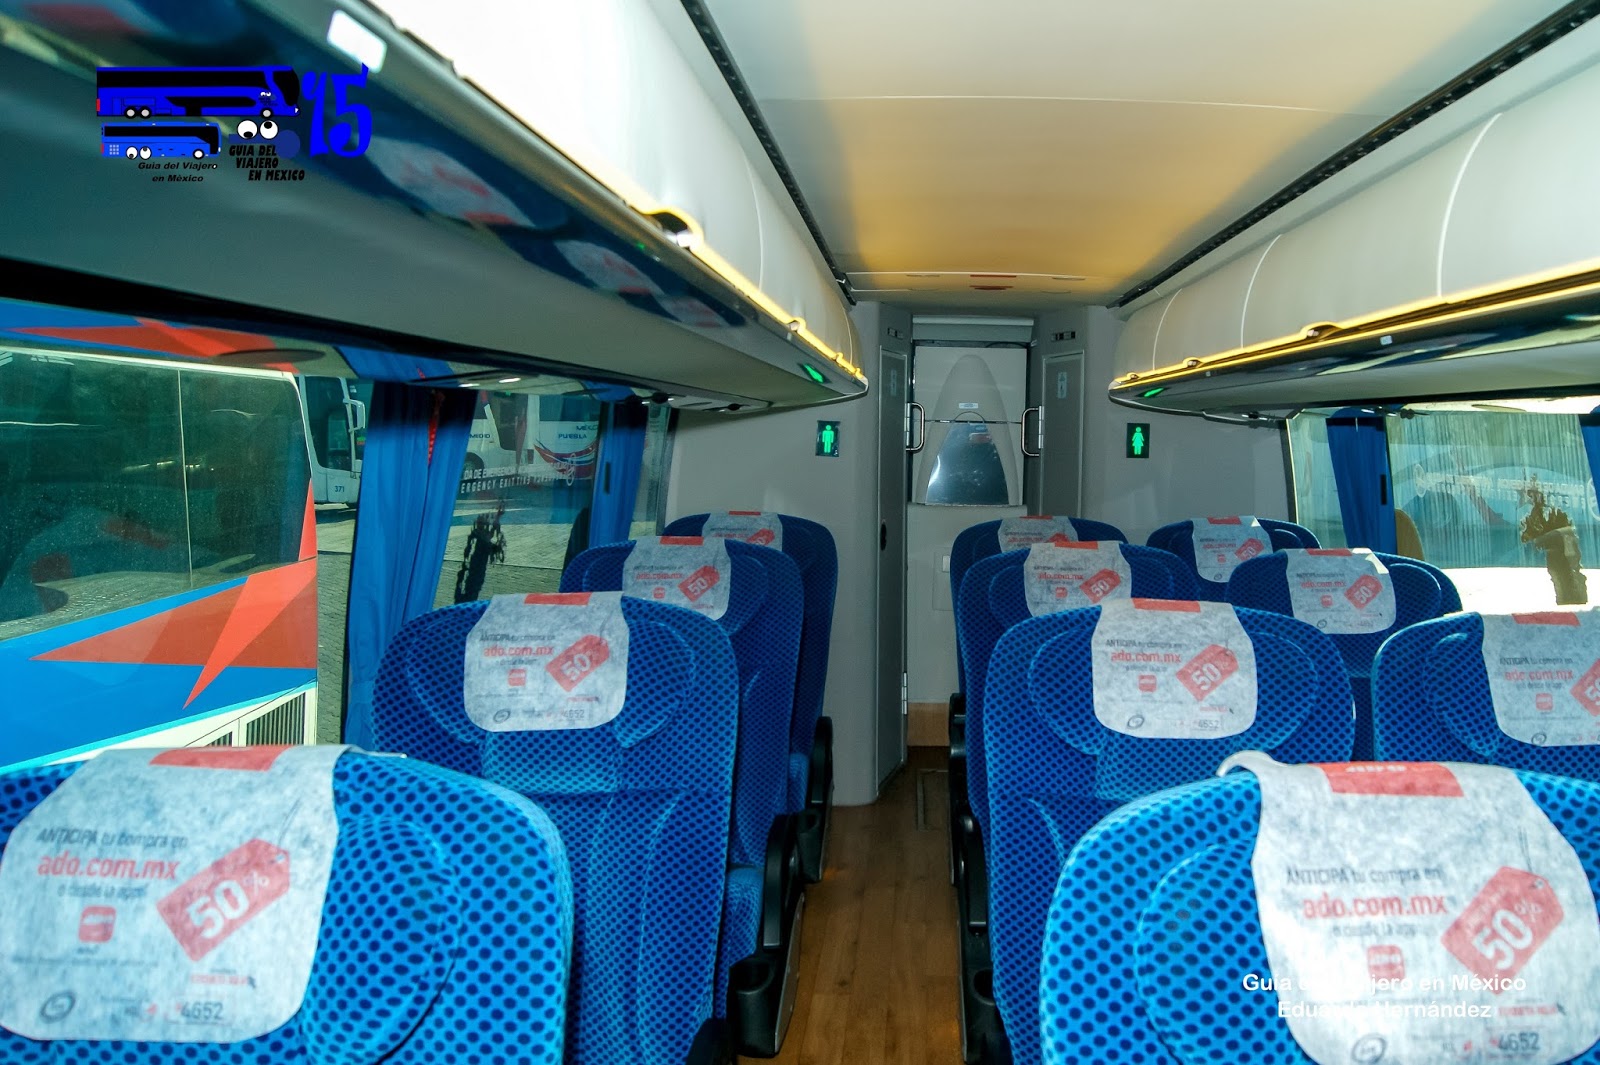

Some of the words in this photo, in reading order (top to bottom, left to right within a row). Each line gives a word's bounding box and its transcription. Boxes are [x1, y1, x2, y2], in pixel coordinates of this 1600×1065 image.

[334, 485, 345, 493] 371
[1111, 649, 1181, 664] ado.com.mx
[38, 850, 180, 879] ado.com.mx
[1303, 890, 1449, 919] ado.com.mx
[181, 1001, 224, 1020] 4652
